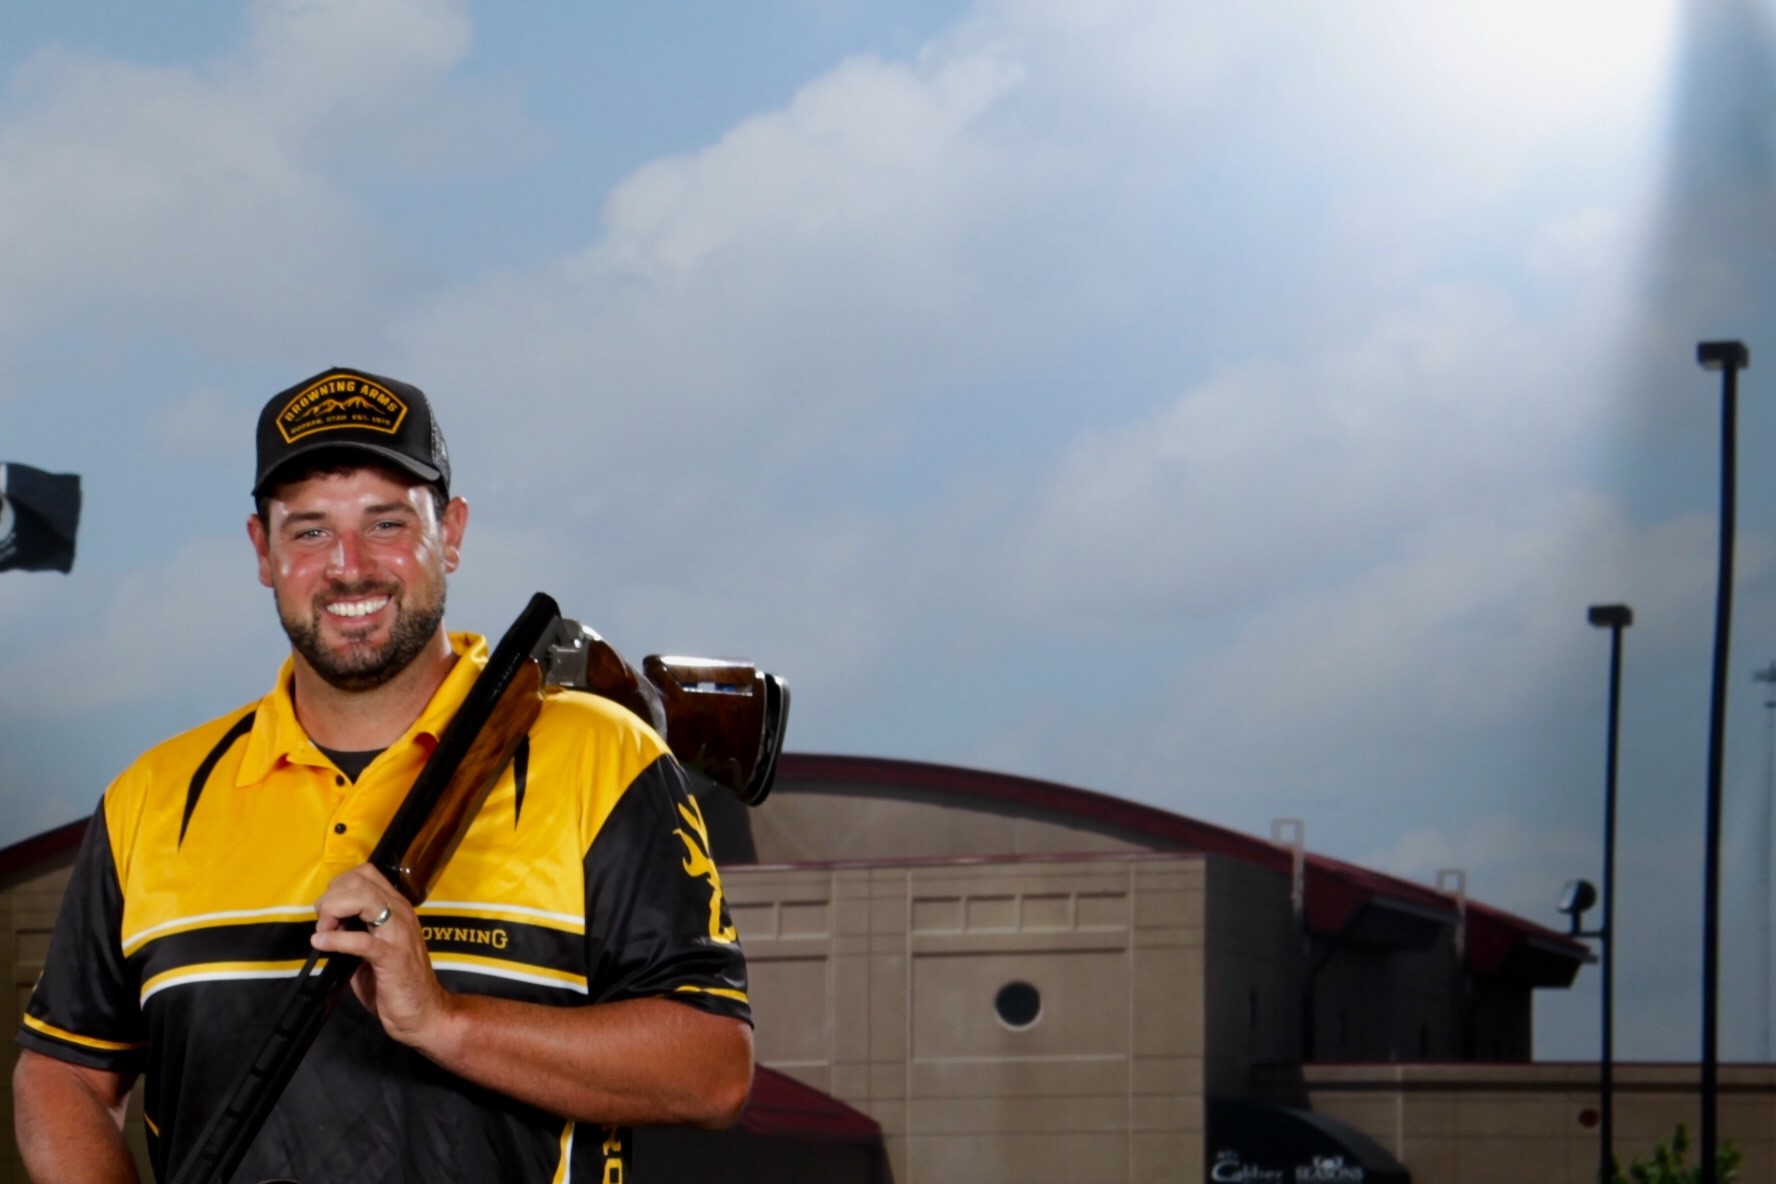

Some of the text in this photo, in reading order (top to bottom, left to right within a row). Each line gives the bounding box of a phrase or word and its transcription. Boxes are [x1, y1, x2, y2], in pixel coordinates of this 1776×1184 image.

[284, 381, 398, 421] BROWNING ARMS
[421, 926, 509, 949] OWNING
